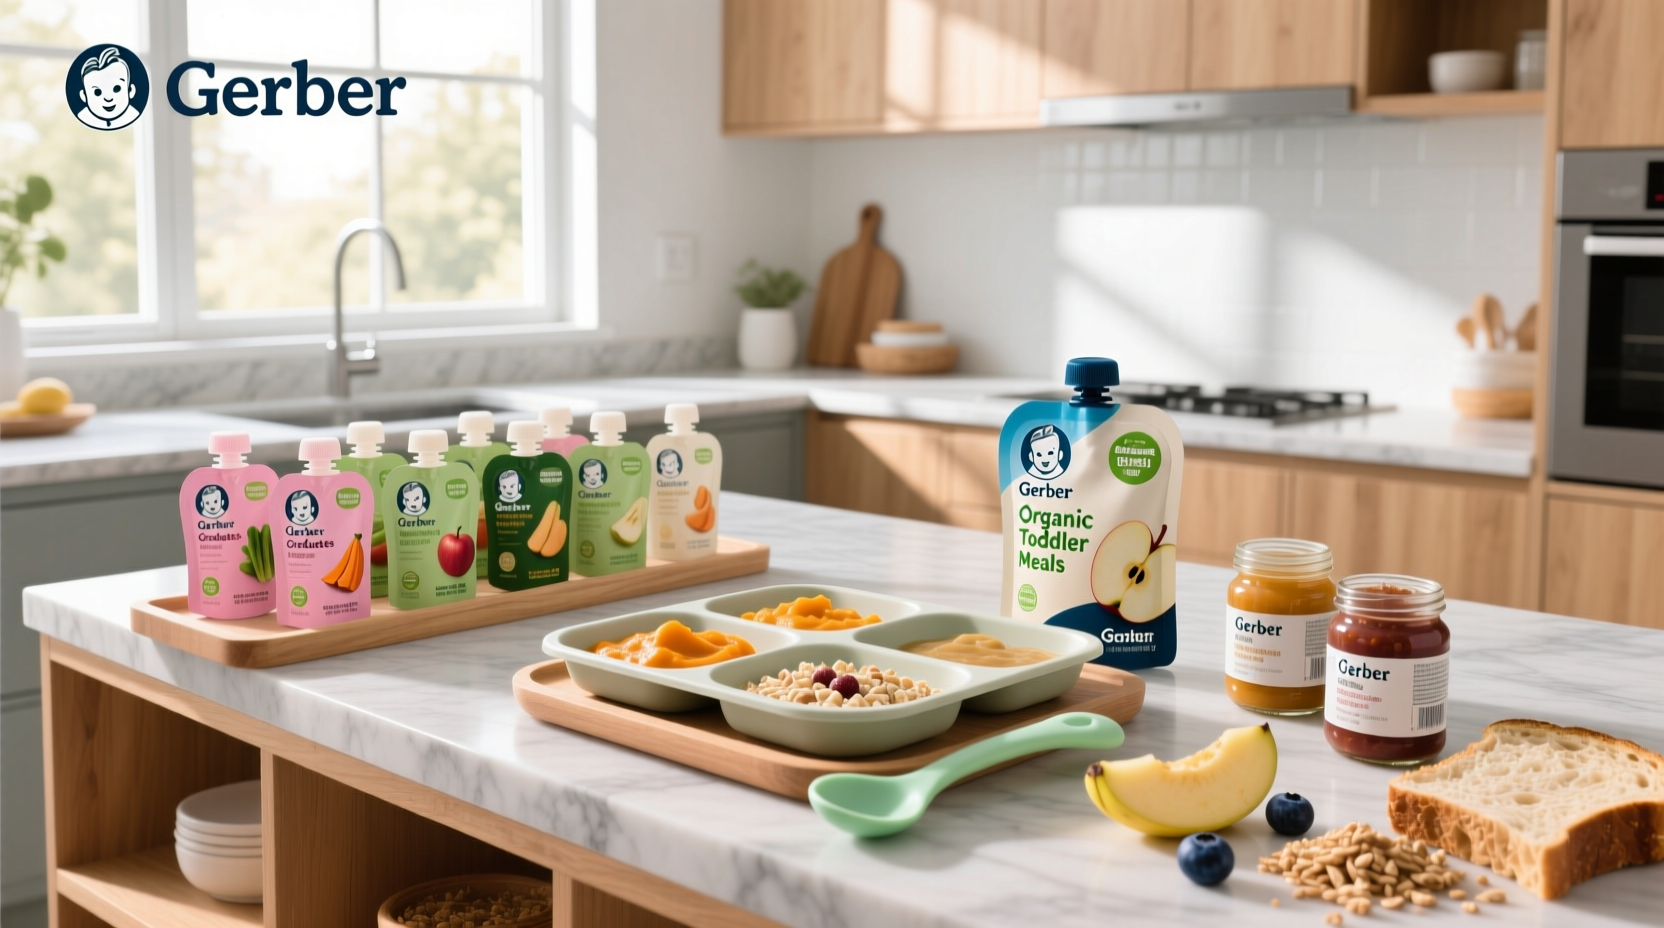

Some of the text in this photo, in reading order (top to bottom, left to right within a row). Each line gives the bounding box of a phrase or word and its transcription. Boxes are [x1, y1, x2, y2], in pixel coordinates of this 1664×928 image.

[1018, 481, 1073, 499] Gerber
[1018, 504, 1094, 530] Organic
[1018, 528, 1090, 552] Toddler
[1018, 550, 1066, 574] Meals
[1234, 616, 1283, 637] Gerber
[1338, 658, 1391, 682] Gerber
